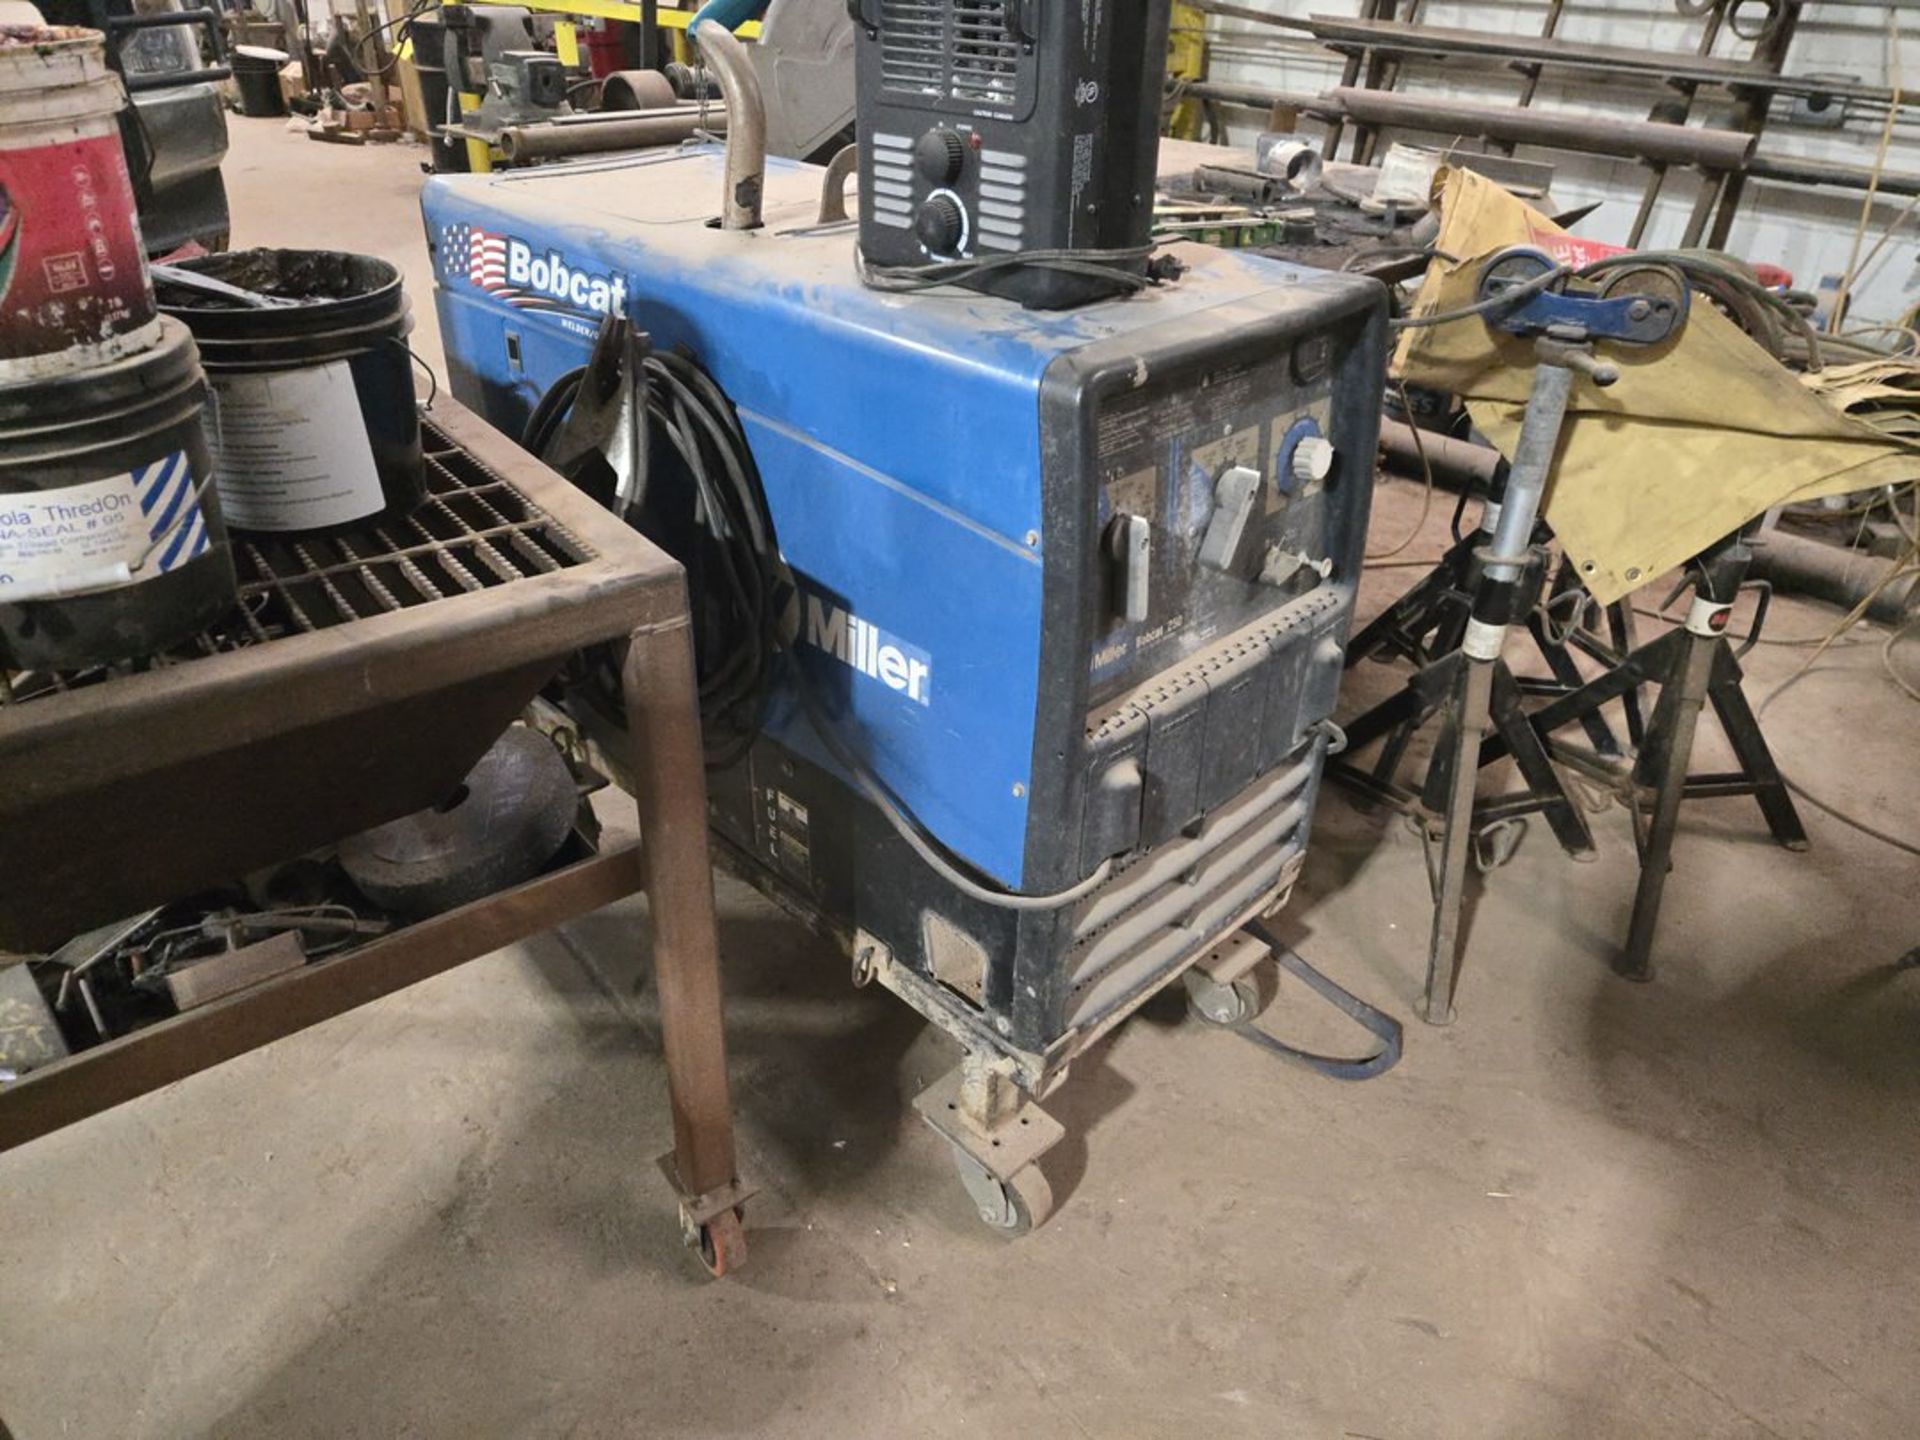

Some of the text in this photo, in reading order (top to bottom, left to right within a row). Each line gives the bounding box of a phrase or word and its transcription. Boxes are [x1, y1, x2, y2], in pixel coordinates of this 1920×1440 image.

[509, 240, 627, 319] Bobcat
[43, 493, 132, 522] ThredOn
[806, 593, 930, 702] Miller
[766, 787, 778, 858] FUEL
